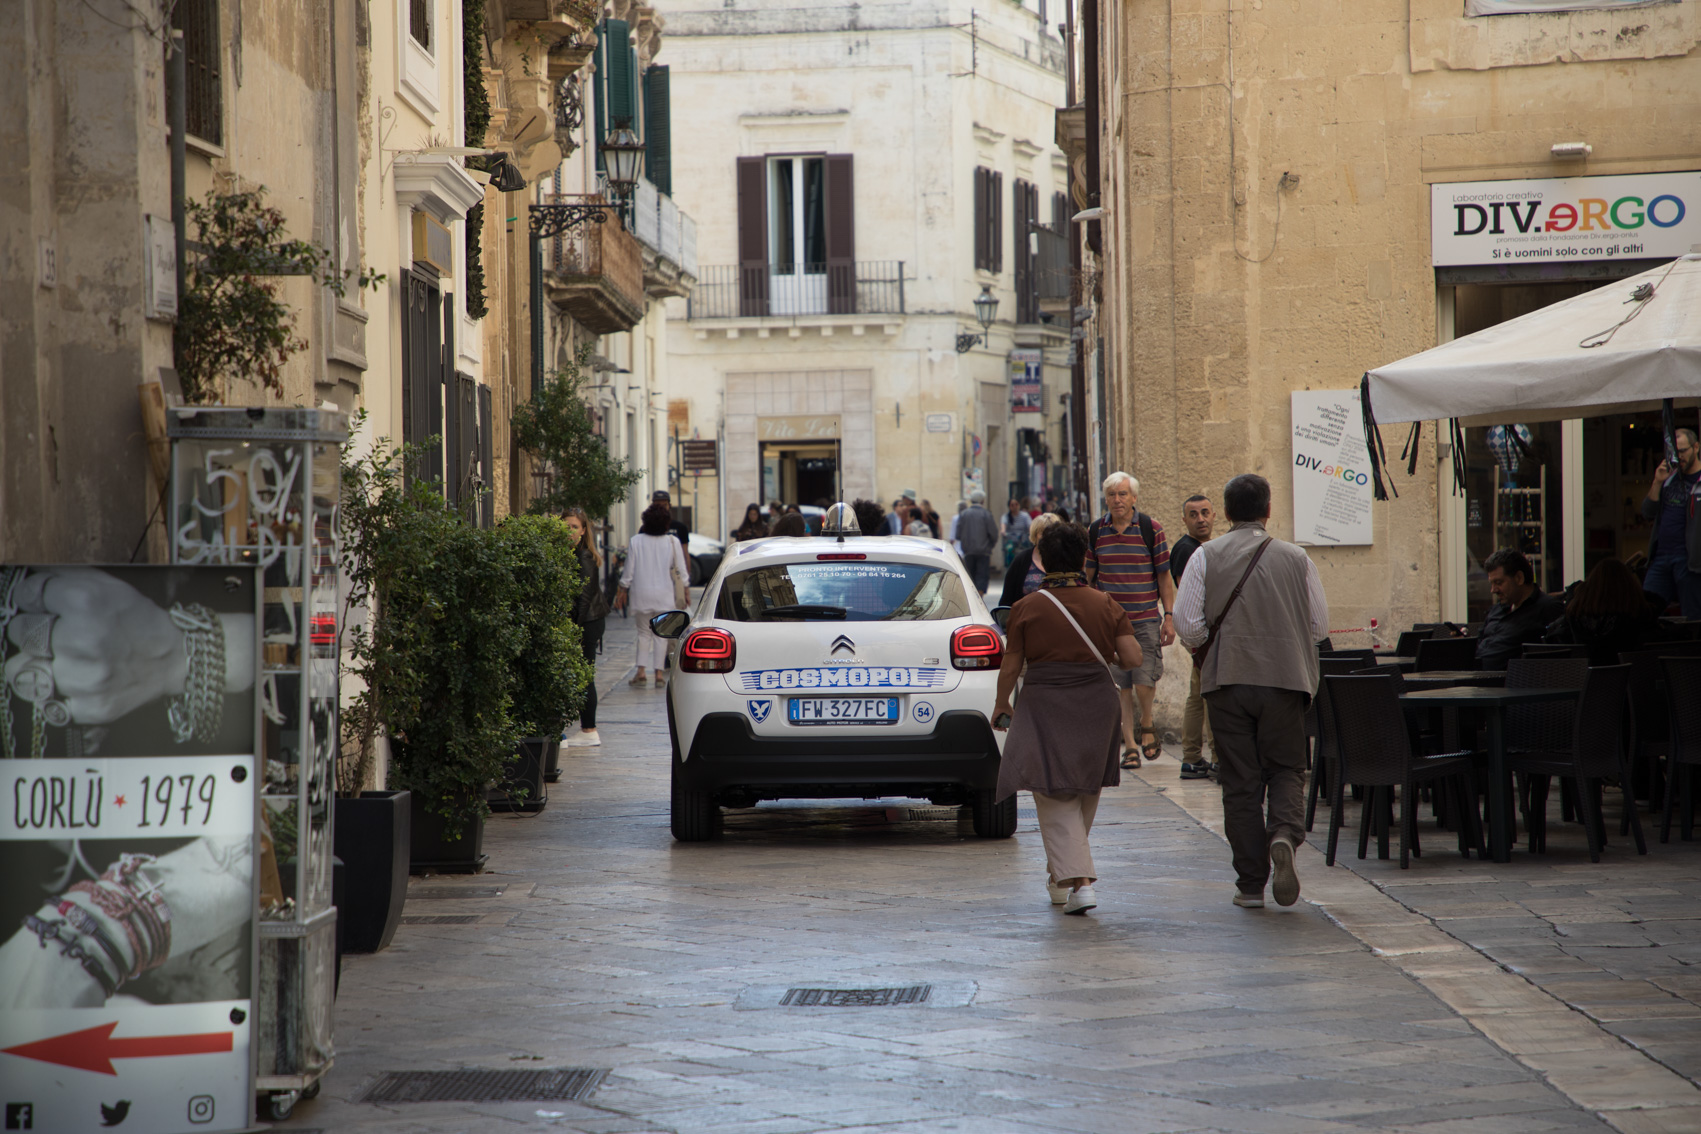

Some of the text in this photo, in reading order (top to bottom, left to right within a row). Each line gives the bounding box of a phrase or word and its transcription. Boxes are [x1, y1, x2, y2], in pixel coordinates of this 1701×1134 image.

[1452, 191, 1544, 202] Laboratorio creativo
[1492, 243, 1644, 258] Si è uomini solo con gli altri
[1317, 405, 1348, 419] trattamento
[1309, 423, 1342, 437] motivazione
[1328, 422, 1344, 431] senza
[1312, 430, 1340, 442] violazione
[922, 657, 940, 665] C3
[759, 668, 930, 689] COSMOPOL
[917, 708, 930, 717] 54
[137, 774, 216, 828] 1979
